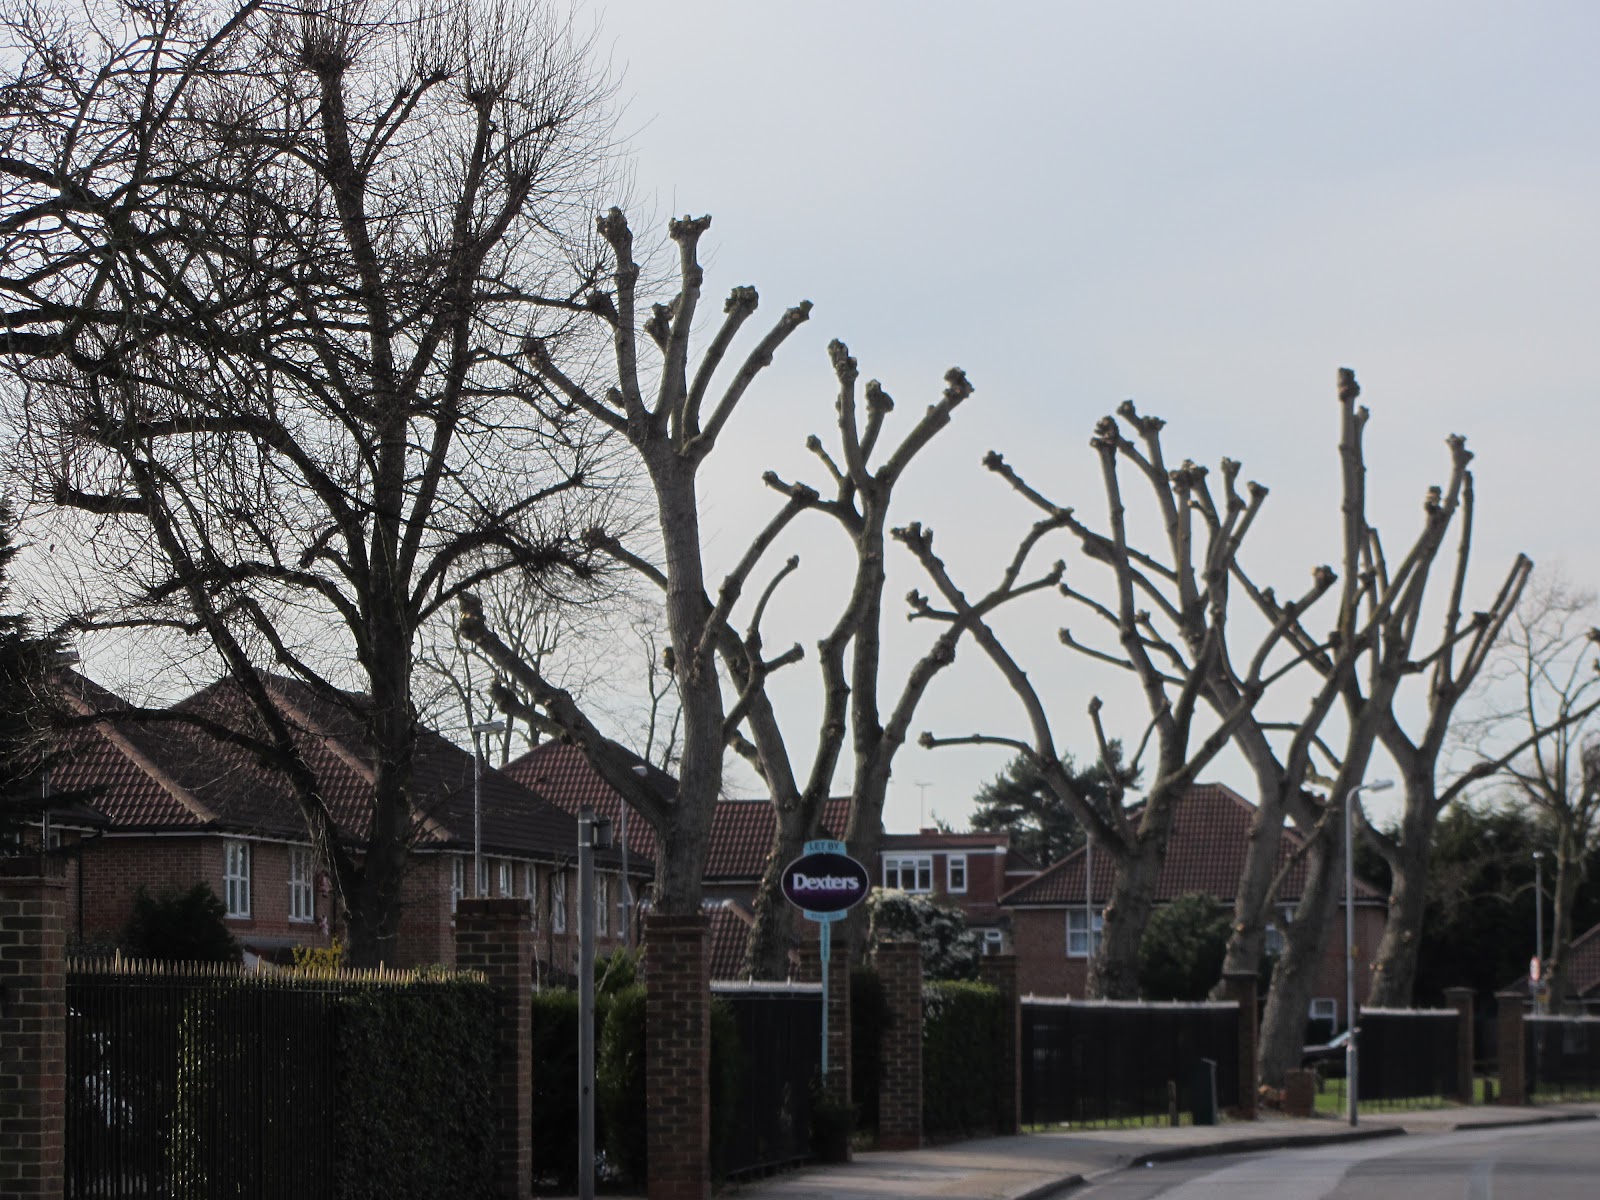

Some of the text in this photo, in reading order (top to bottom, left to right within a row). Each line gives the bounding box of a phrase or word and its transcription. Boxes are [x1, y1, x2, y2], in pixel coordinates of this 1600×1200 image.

[809, 842, 840, 851] LET BY
[793, 873, 859, 890] Dexters
